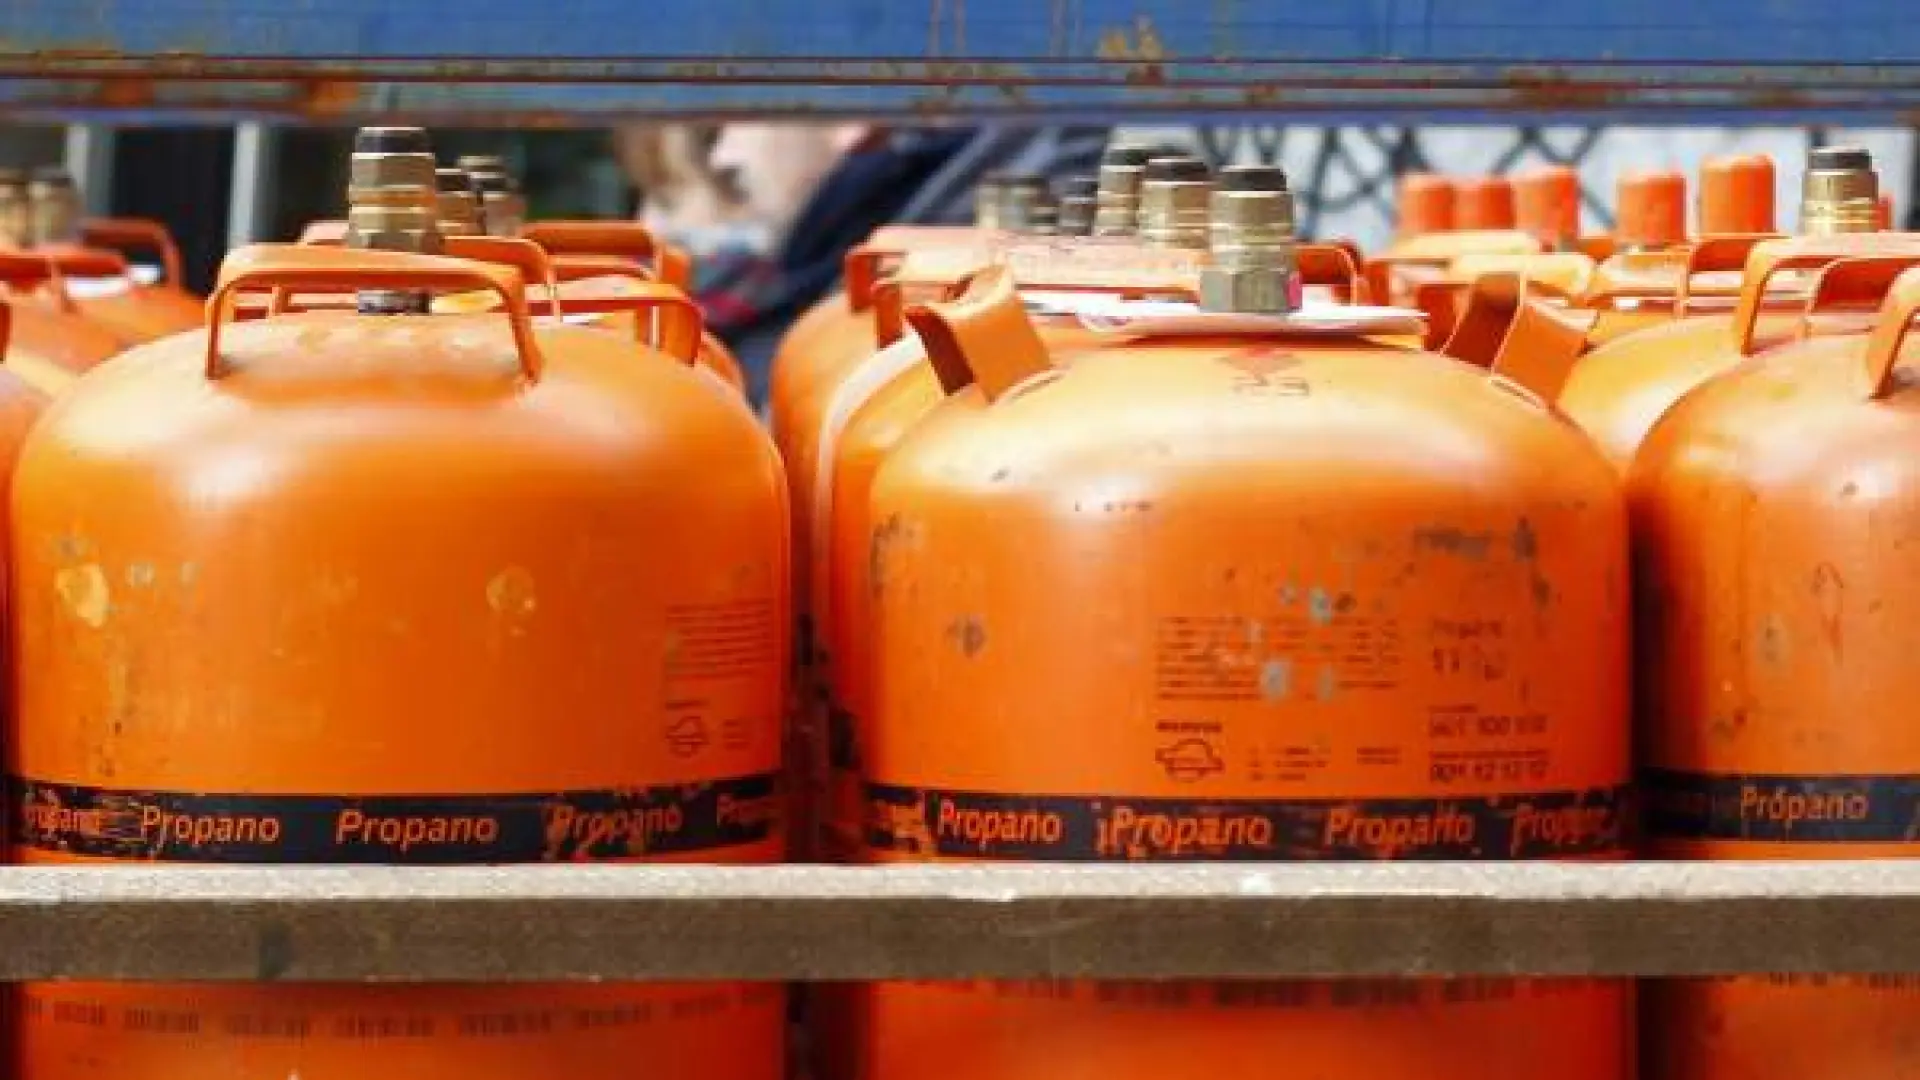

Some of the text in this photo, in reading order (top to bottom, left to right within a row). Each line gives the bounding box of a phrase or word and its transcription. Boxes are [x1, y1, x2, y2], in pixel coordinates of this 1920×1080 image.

[141, 804, 281, 847] Propano
[335, 808, 497, 848] Propano
[547, 803, 684, 849] Propano
[936, 800, 1061, 849] Propano
[1110, 804, 1273, 854] Propano
[1324, 806, 1476, 853] Propano
